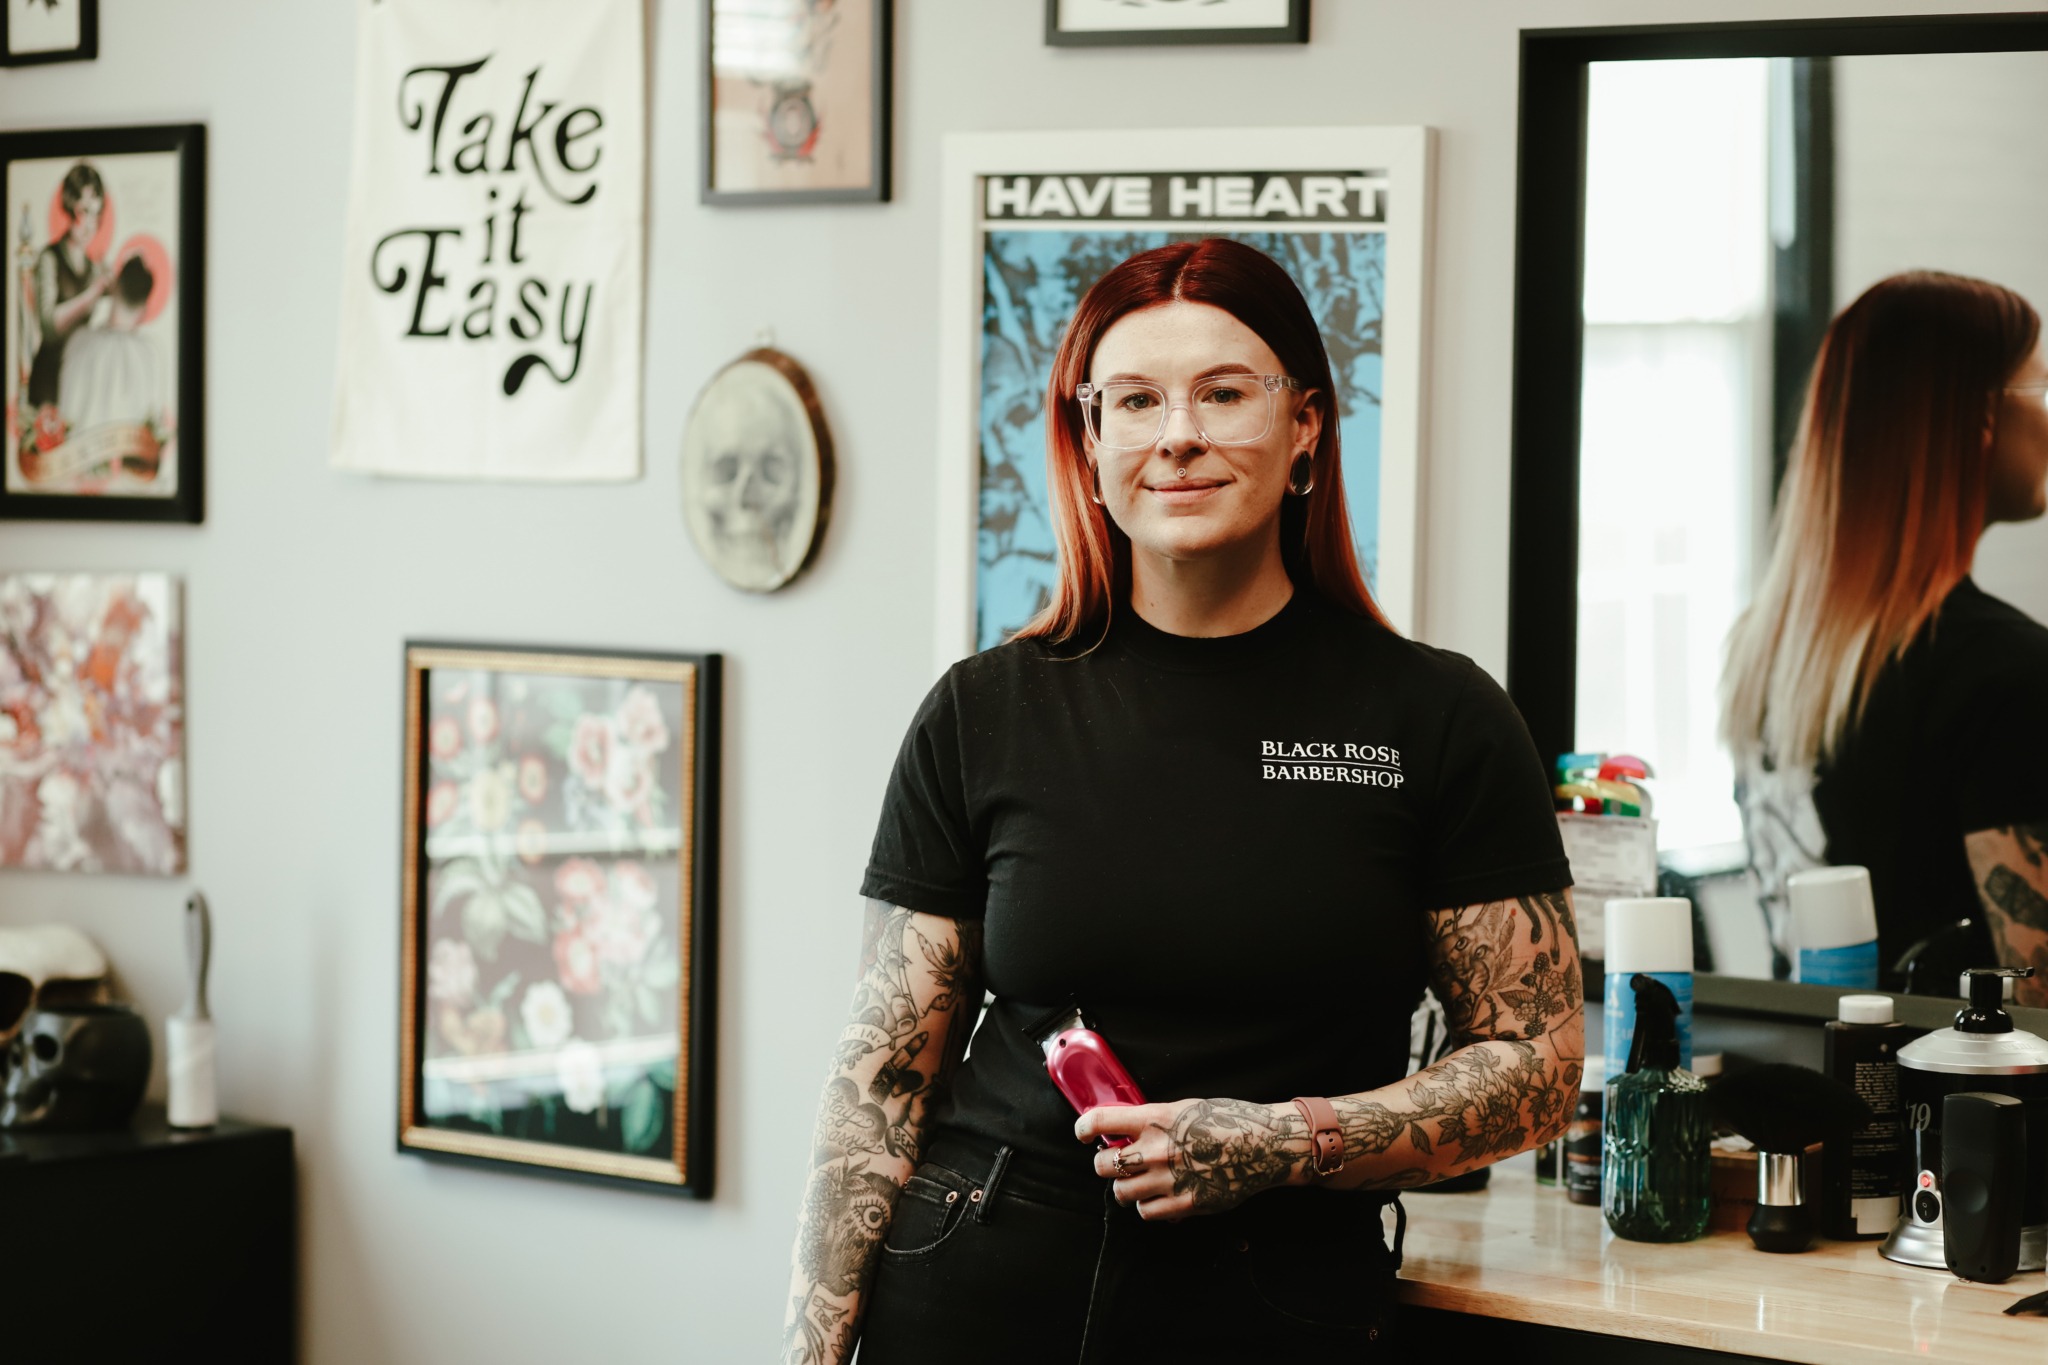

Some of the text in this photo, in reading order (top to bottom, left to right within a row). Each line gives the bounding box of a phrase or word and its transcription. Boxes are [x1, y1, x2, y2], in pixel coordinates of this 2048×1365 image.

[398, 52, 603, 205] Take
[986, 175, 1390, 217] HAVE HEART
[483, 187, 533, 264] it
[372, 228, 593, 396] Easy
[1261, 740, 1401, 767] BLACK ROSE
[1262, 764, 1405, 789] BARBERSHOP
[818, 1087, 875, 1129] Stay
[814, 1116, 886, 1157] Sassy
